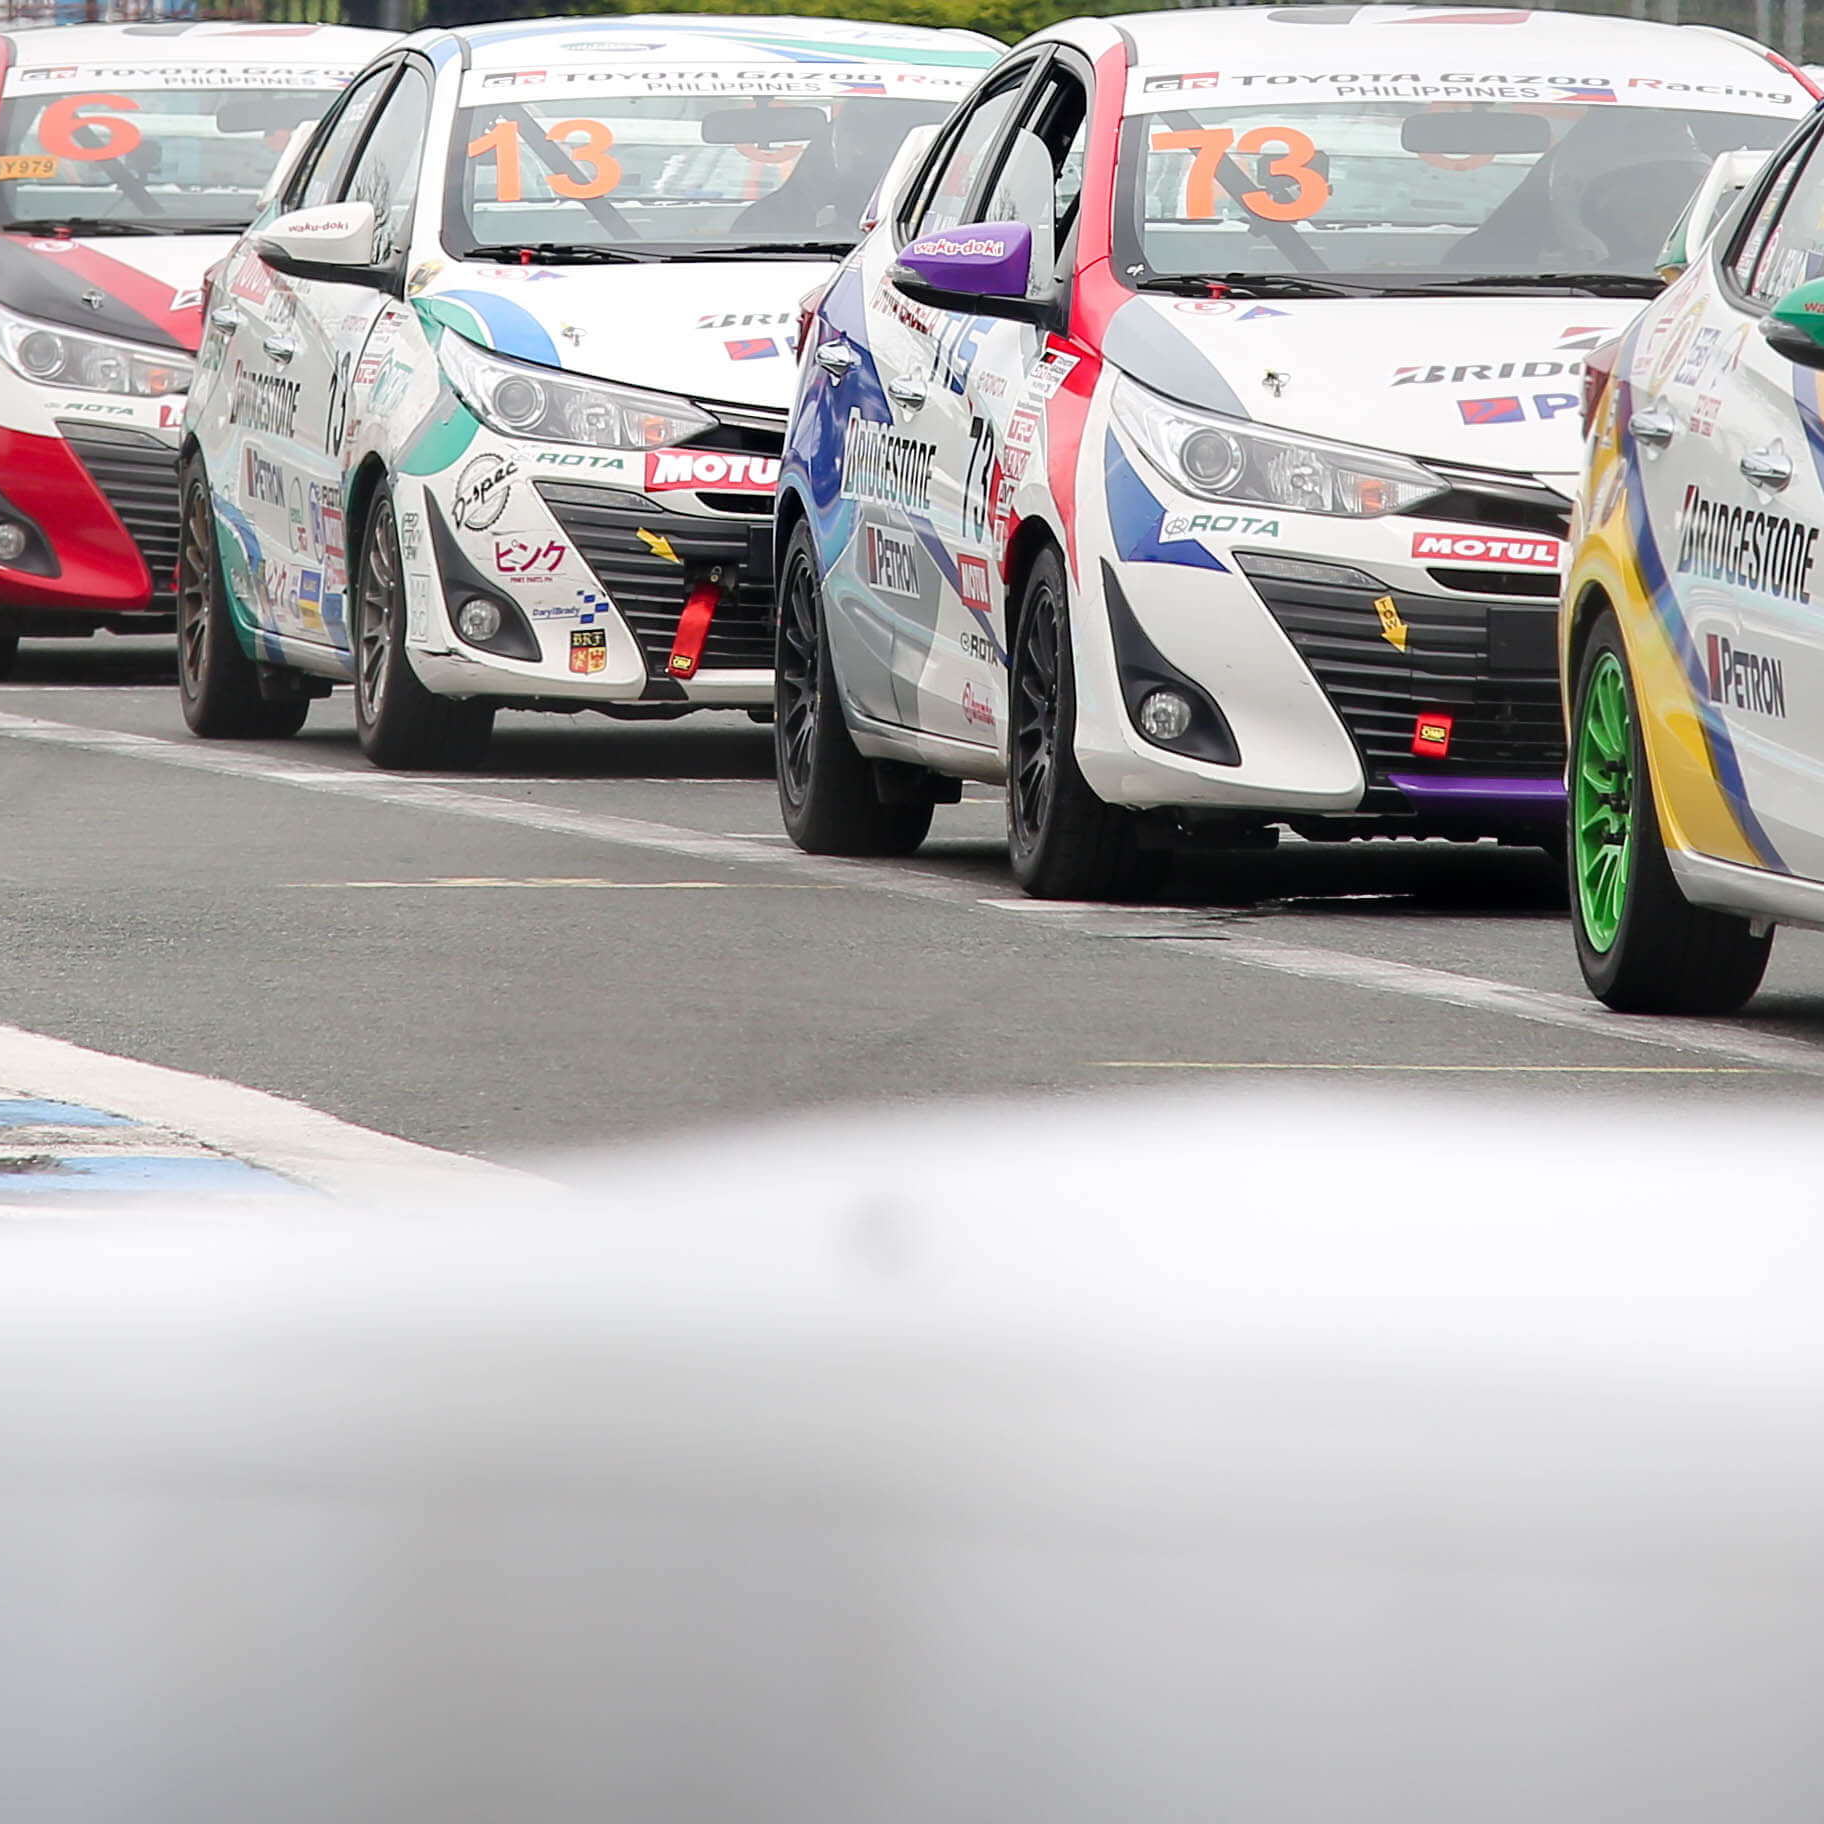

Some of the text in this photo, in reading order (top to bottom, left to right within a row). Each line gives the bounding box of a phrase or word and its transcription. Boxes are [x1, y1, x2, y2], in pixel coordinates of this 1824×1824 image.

[163, 76, 317, 87] PHILIPPINES
[564, 70, 976, 87] TOYOTA GAZOO Rac
[647, 82, 822, 93] PHILIPPINES
[1231, 72, 1794, 106] TOYOTA GAZOO Racing
[1336, 85, 1540, 100] PHILIPPINES
[39, 92, 142, 162] 6
[5, 159, 54, 175] Y979
[467, 118, 623, 203] 13
[1151, 126, 1331, 222] 73
[914, 238, 1005, 256] waku-doki
[63, 403, 135, 417] ROTA
[535, 452, 625, 471] ROTA
[651, 453, 778, 485] MOTU
[844, 415, 938, 515] BRIDGESTONE
[961, 415, 996, 543] 73
[1187, 514, 1280, 538] ROTA
[495, 540, 566, 572] ピンク
[1416, 536, 1558, 562] MOTUL
[1678, 485, 1821, 605] BRIDGESTONE
[875, 530, 920, 596] PETRON
[1720, 637, 1787, 719] PETRON
